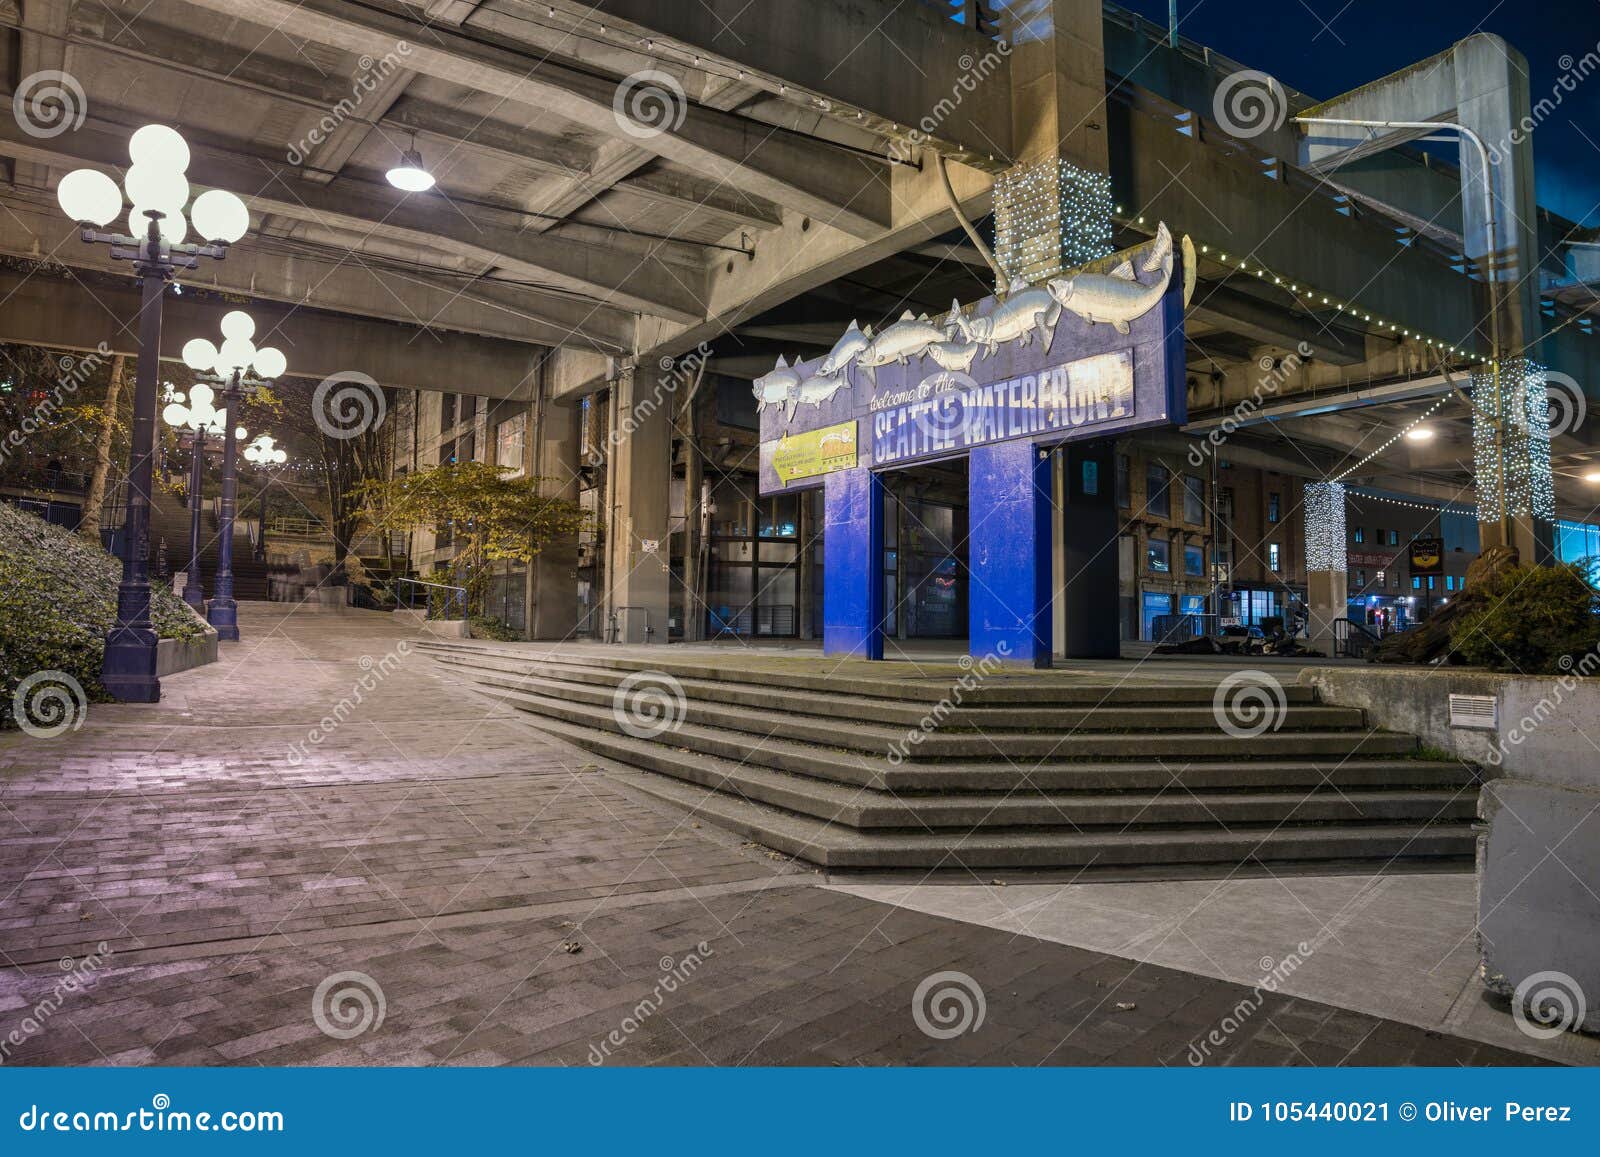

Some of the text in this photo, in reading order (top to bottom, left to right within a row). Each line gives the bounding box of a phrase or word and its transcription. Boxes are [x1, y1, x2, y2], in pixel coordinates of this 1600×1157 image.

[870, 373, 955, 411] welcome to the
[875, 395, 955, 463] SEATTLE
